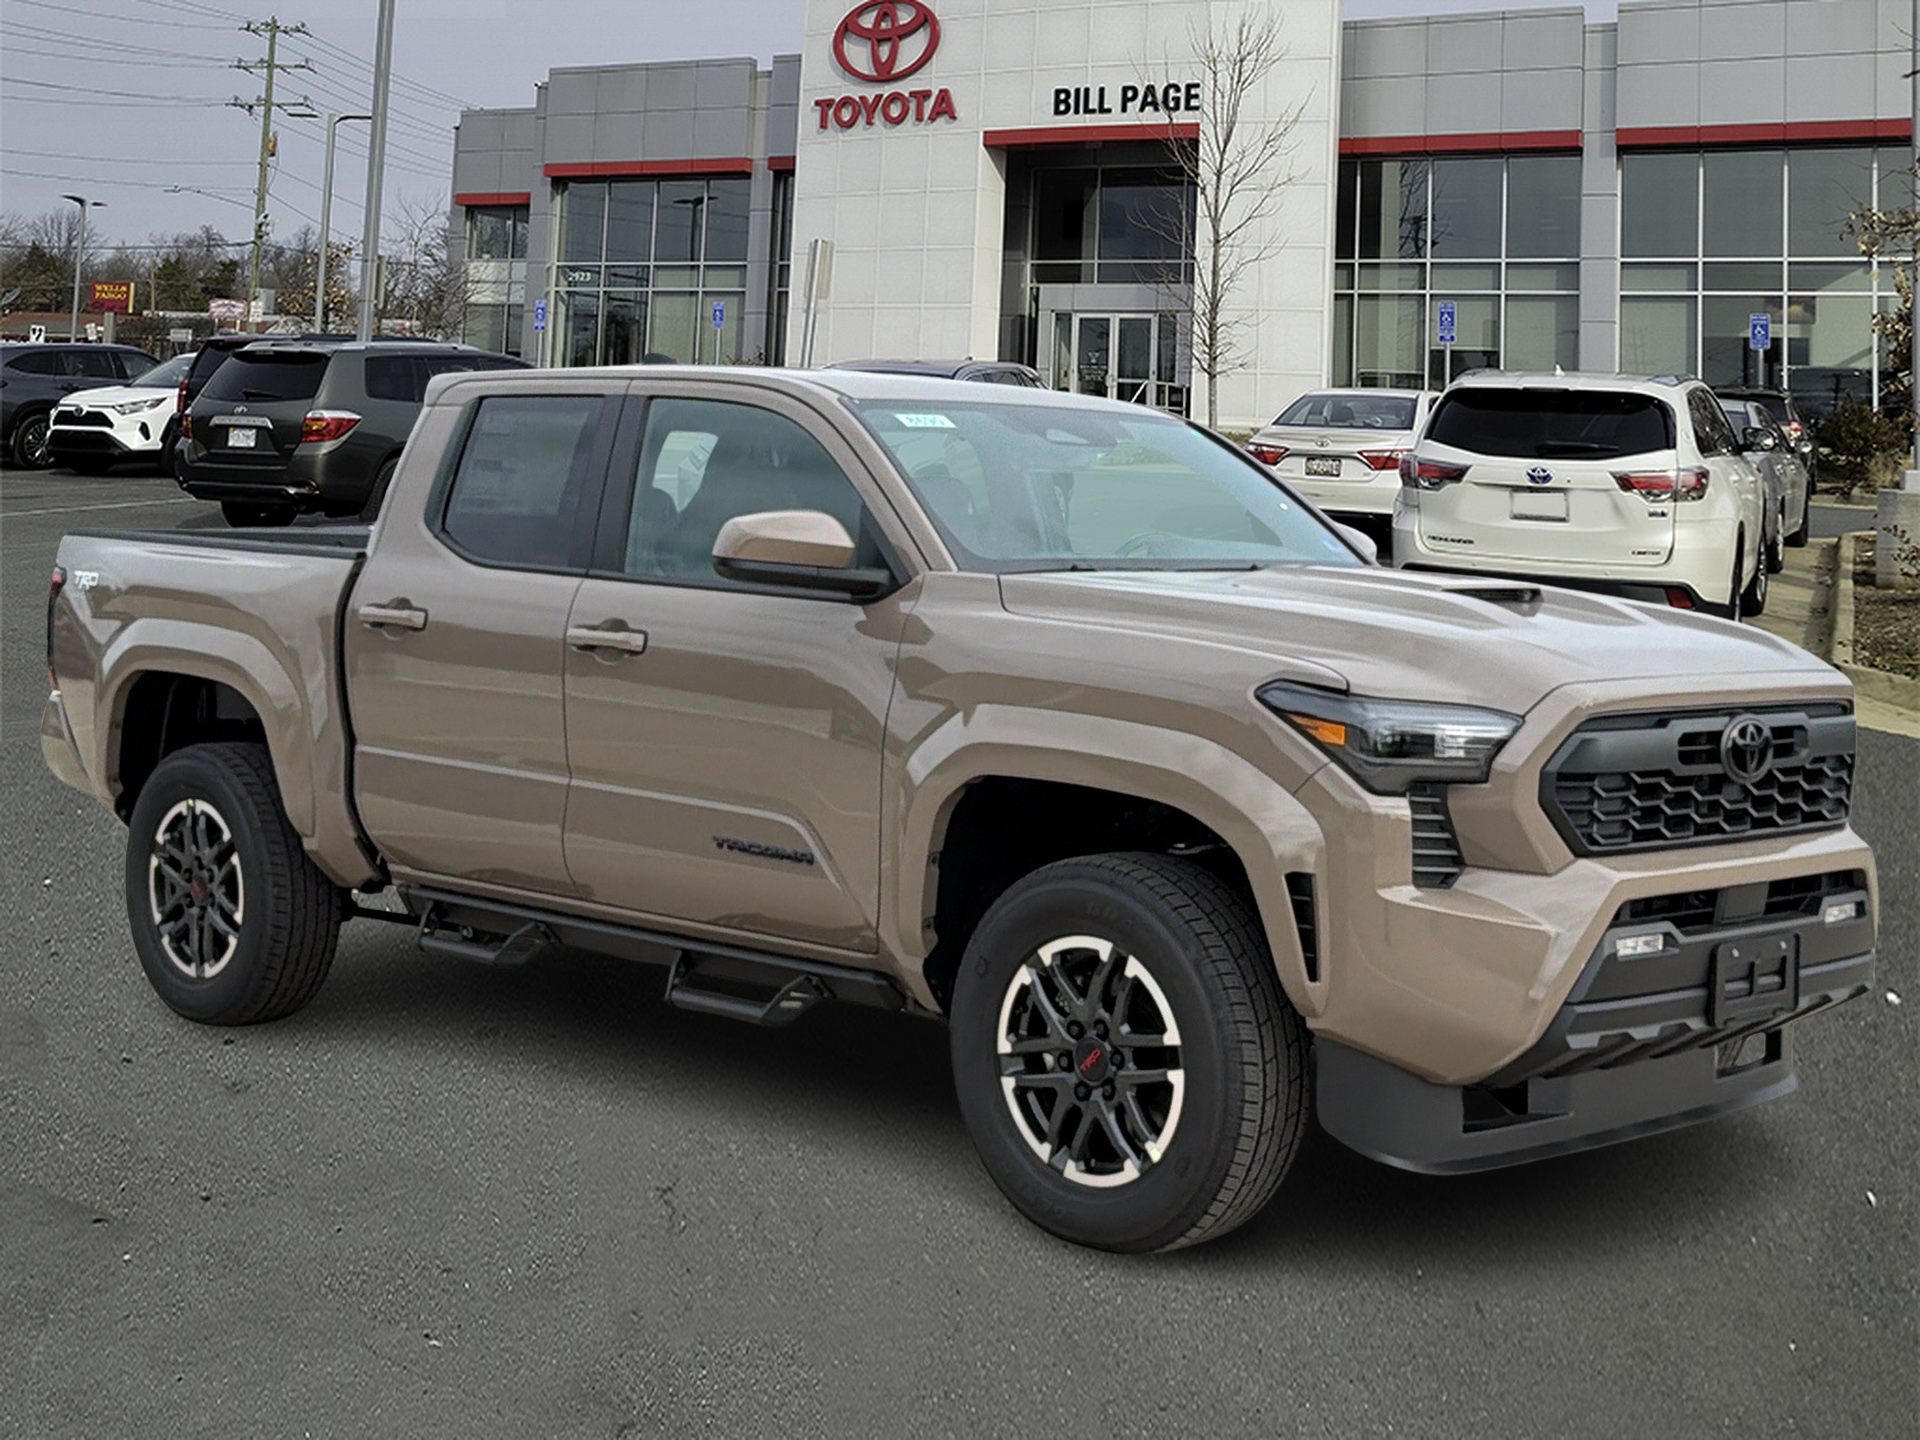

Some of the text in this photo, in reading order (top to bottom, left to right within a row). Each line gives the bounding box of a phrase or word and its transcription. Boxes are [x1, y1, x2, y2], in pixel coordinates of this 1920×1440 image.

[814, 88, 957, 129] TOYOTA
[1053, 83, 1201, 115] BILL PAGE
[94, 284, 127, 292] WELLS
[94, 291, 127, 300] FARGO
[73, 570, 100, 590] TRD
